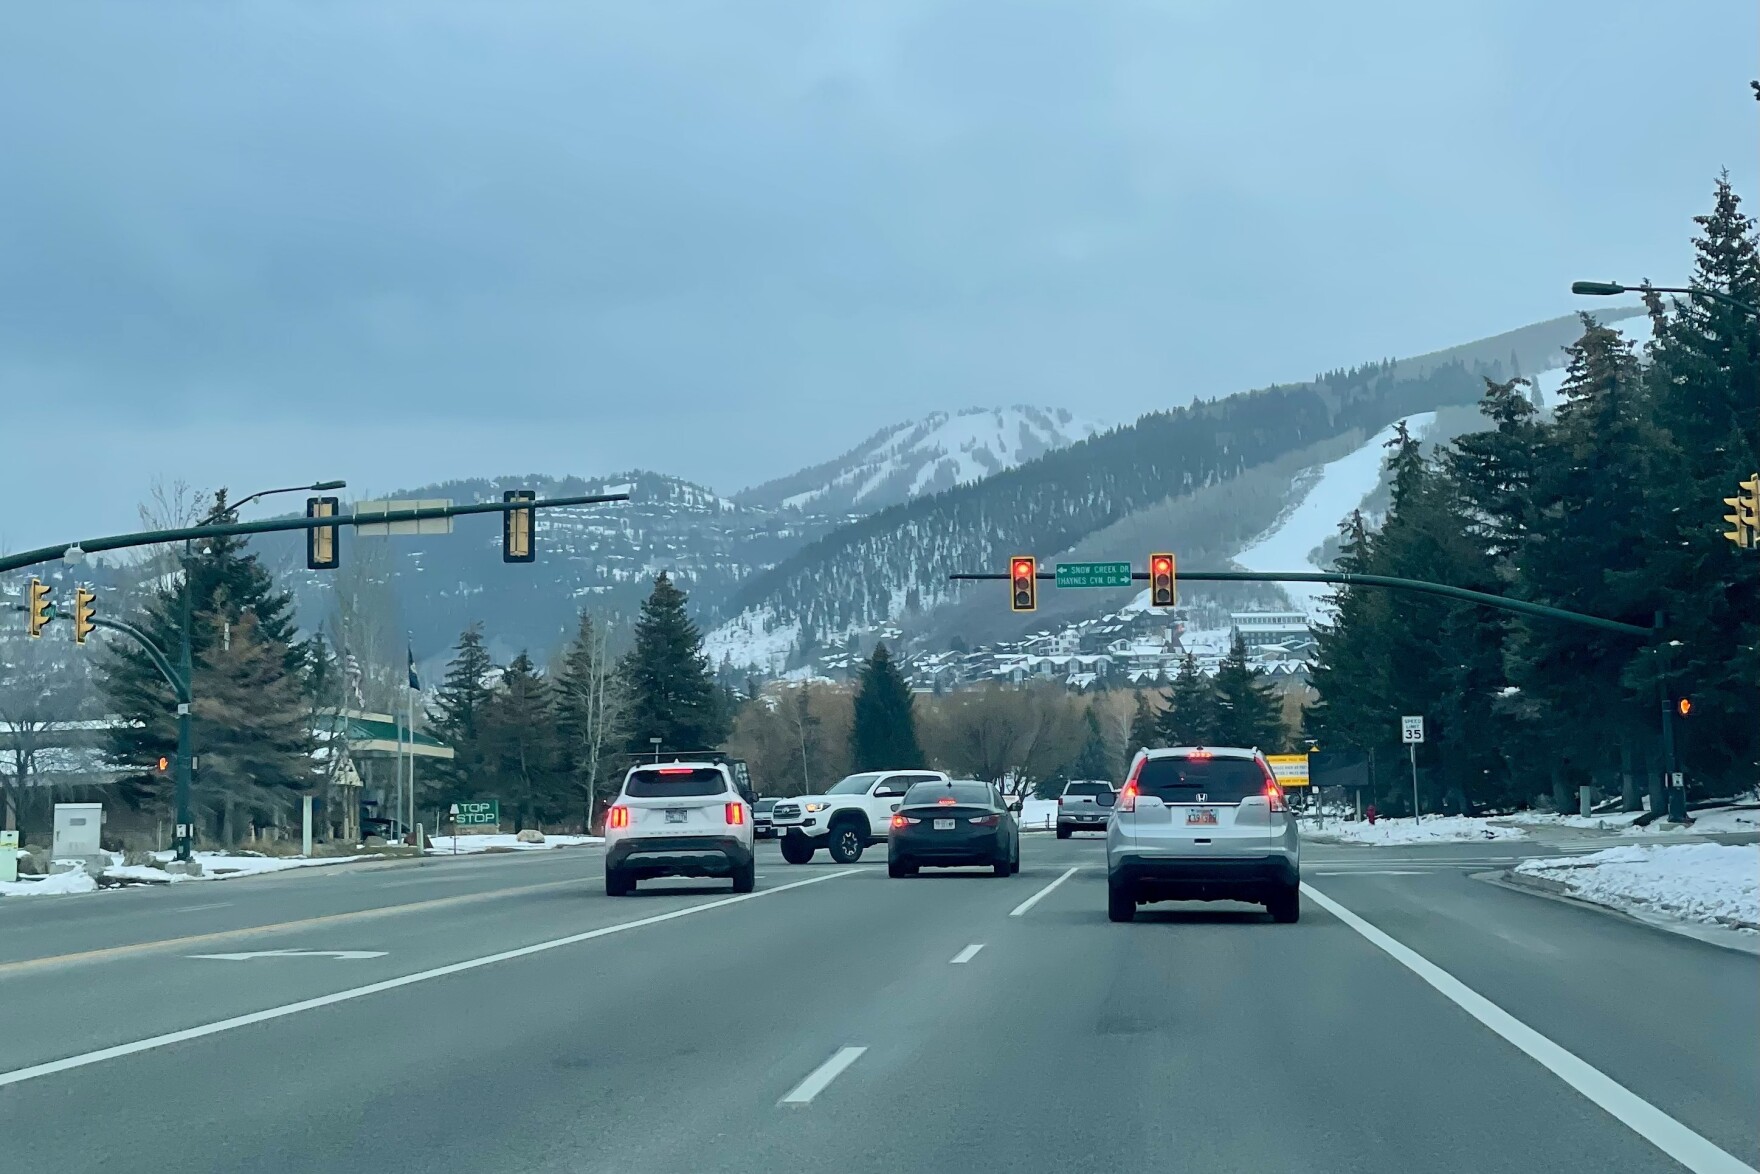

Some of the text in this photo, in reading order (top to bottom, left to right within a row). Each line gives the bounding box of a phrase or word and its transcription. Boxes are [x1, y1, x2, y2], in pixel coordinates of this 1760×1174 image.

[1071, 565, 1130, 574] SNOW CREEK DR
[1057, 576, 1087, 585] THAYNES
[1405, 729, 1421, 739] 35
[460, 803, 490, 812] TOP
[456, 813, 495, 823] STOP
